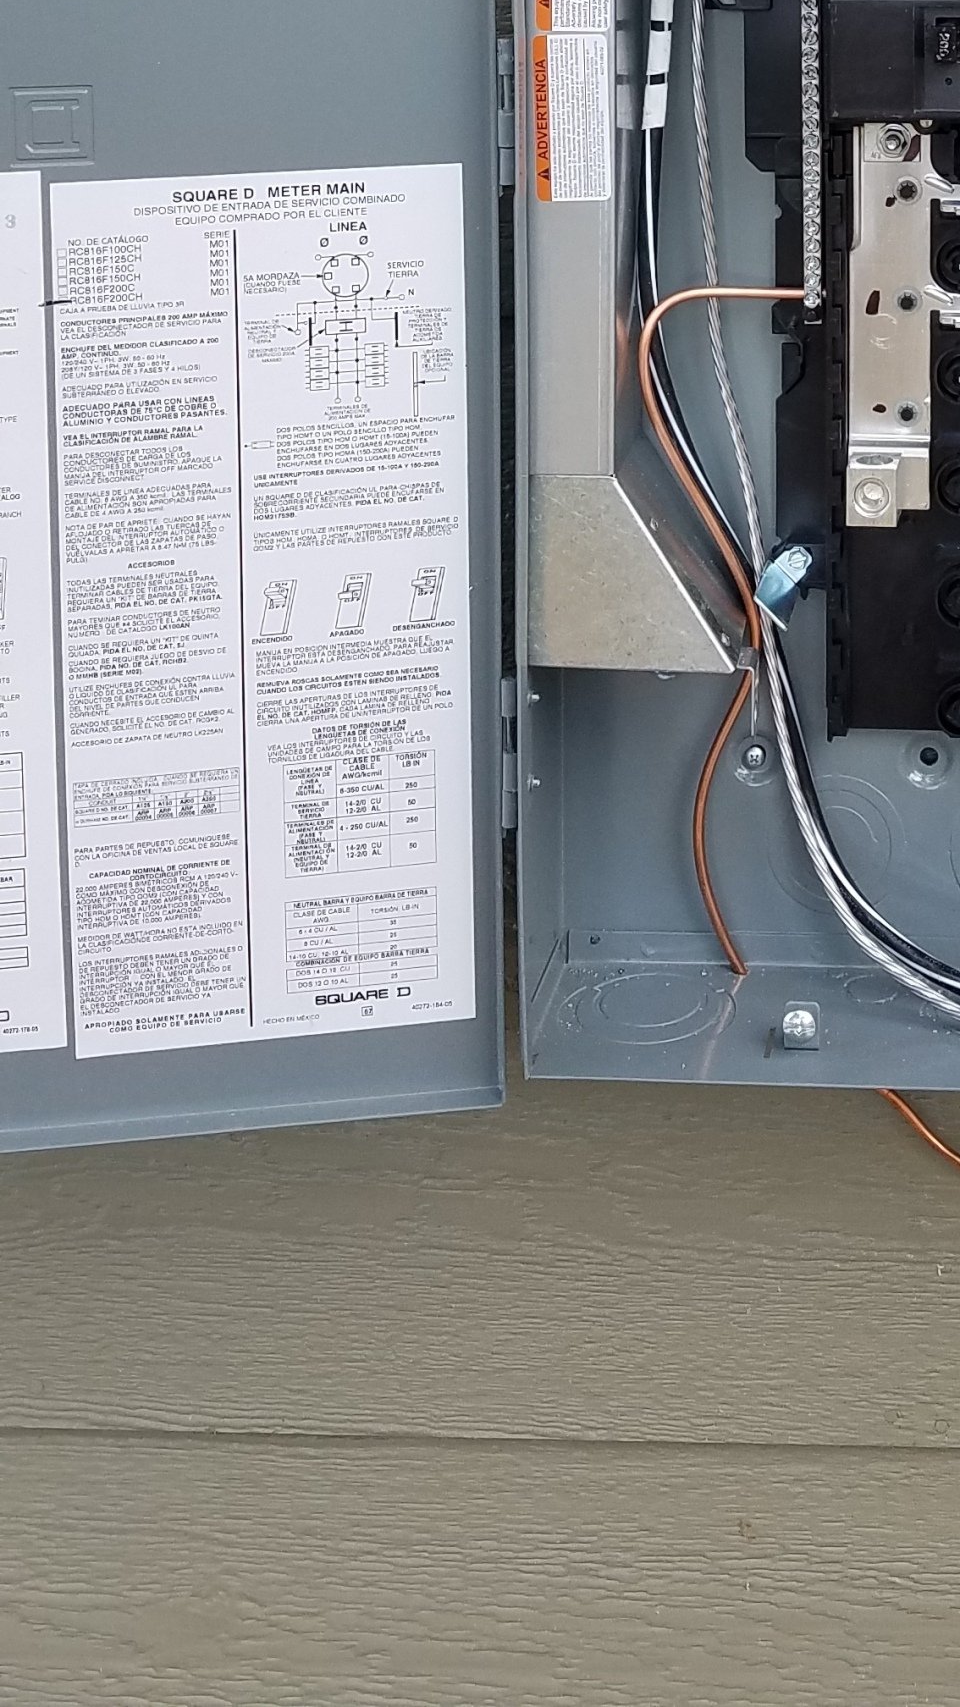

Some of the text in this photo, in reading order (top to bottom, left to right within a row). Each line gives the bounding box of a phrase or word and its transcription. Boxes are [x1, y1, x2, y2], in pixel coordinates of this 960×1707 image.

[535, 58, 549, 160] ADVERTENCIA
[172, 182, 364, 203] SQUARE D METER MAIN
[133, 193, 405, 216] DISPOSITIVO DE ENTRADA DE SERVICIO COMBINADO
[175, 207, 367, 225] EQUIPO COMPRADO POR EL CLIENTE
[329, 220, 367, 232] LINEA
[86, 237, 98, 245] DE
[101, 233, 148, 244] CATÁLOGO
[203, 230, 229, 239] SERIE
[209, 239, 228, 248] M01
[68, 244, 141, 256] RC816F100CH
[209, 249, 228, 258] M01
[68, 253, 141, 266] RC816F125CH
[209, 258, 228, 267] M01
[387, 260, 424, 269] SERVICIO
[69, 263, 134, 276] RC816F150C
[209, 268, 228, 277] M01
[387, 269, 418, 278] TIERRA
[69, 273, 140, 285] RC816F150CH
[210, 278, 228, 286] M01
[243, 271, 299, 282] 5A MORDAZA
[69, 283, 135, 295] RC816F200C
[210, 287, 229, 296] M01
[62, 395, 214, 412] ADECUADO PARA USAR CON LINEAS
[62, 408, 127, 420] CONDUCTORAS
[130, 407, 141, 415] DE
[164, 404, 176, 412] DE
[178, 402, 207, 411] COBRE
[62, 417, 103, 427] ALUMINIO
[113, 412, 178, 423] CONDUCTORES
[90, 429, 142, 439] INTERRUPTOR
[144, 427, 169, 435] RAMAL
[63, 436, 119, 447] CLASIFICACIÓN
[133, 433, 167, 442] ALAMBRE
[127, 559, 174, 569] ACCESORIOS
[392, 620, 455, 631] DESENGANCHADO
[329, 628, 364, 637] APAGADO
[251, 635, 292, 644] ENCENDIDO
[342, 754, 381, 765] CLASE DE
[394, 750, 427, 761] TORSIÓN
[349, 762, 375, 771] CABLE
[361, 783, 384, 791] CU/AL
[405, 781, 417, 789] 250
[345, 797, 381, 807] 14-2/0 CU
[345, 805, 366, 814] 12-2/0
[406, 815, 418, 823] 250
[350, 822, 363, 830] 250
[365, 820, 388, 829] CU/AL
[345, 841, 381, 851] 14-2/0 CU
[346, 848, 381, 858] 12-2/0 AL
[315, 986, 411, 1006] SQUARE D
[84, 1007, 245, 1030] APROPIADO SOLAMENTE PARA USARSE
[109, 1025, 133, 1033] COMO
[136, 1021, 166, 1030] EQUIPO
[183, 1016, 221, 1025] SERVICIO
